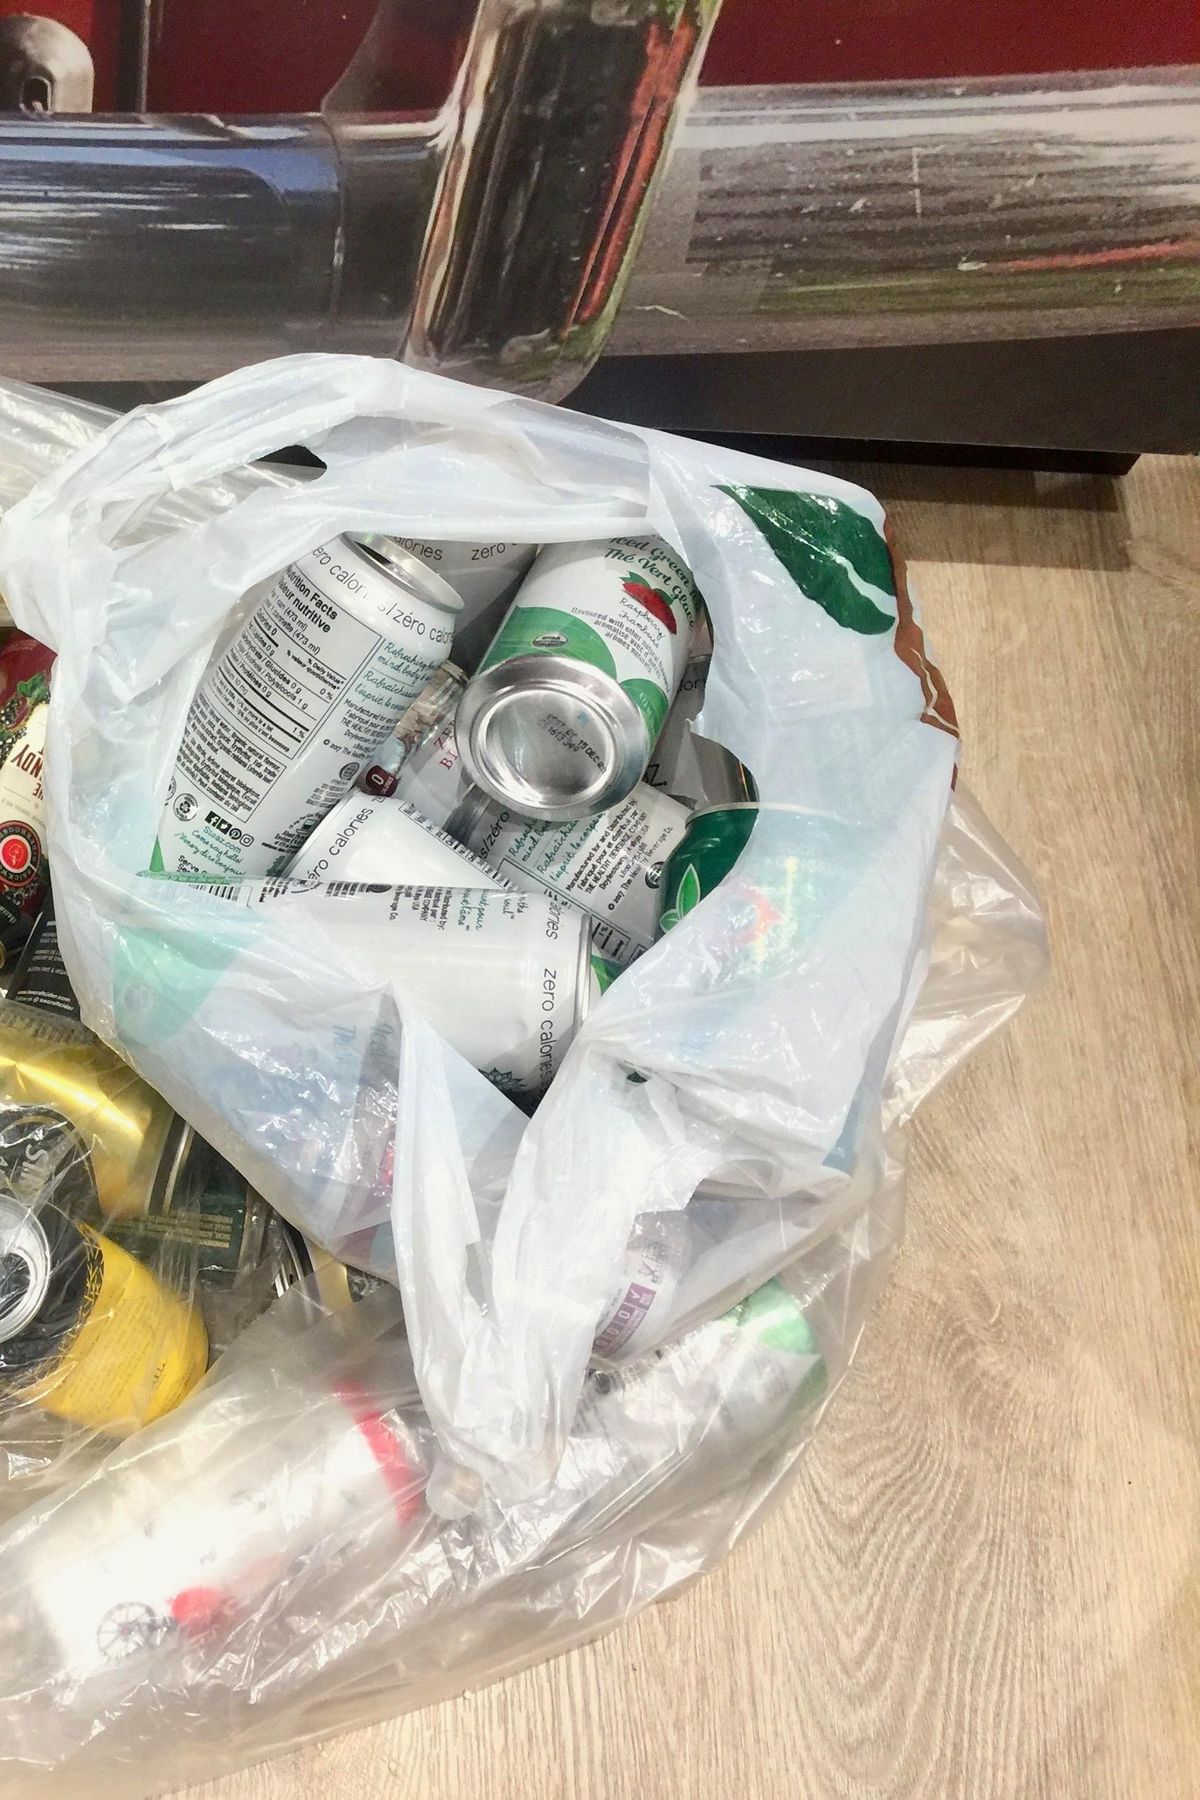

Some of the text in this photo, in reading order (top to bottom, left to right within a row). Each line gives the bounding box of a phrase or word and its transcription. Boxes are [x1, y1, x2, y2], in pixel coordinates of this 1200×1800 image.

[312, 546, 331, 566] ero
[472, 542, 506, 560] zero
[604, 544, 637, 564] Thé
[636, 555, 674, 587] Vert
[648, 544, 692, 588] Green
[283, 605, 299, 623] (473
[291, 595, 332, 634] nutritive
[309, 592, 339, 620] Facts
[619, 596, 666, 640] Raspberry
[291, 627, 309, 646] (473
[319, 687, 327, 696] 0
[10, 743, 44, 778] NDY
[584, 747, 600, 763] DEC
[328, 806, 375, 859] calories
[177, 854, 200, 872] Serve
[565, 851, 594, 891] Manufactured
[577, 863, 597, 890] Fabriqué
[596, 849, 608, 864] pour
[585, 882, 595, 894] THE
[592, 859, 611, 883] HEALTHY
[621, 877, 632, 890] The
[541, 968, 558, 1012] zero
[538, 1019, 557, 1087] calories
